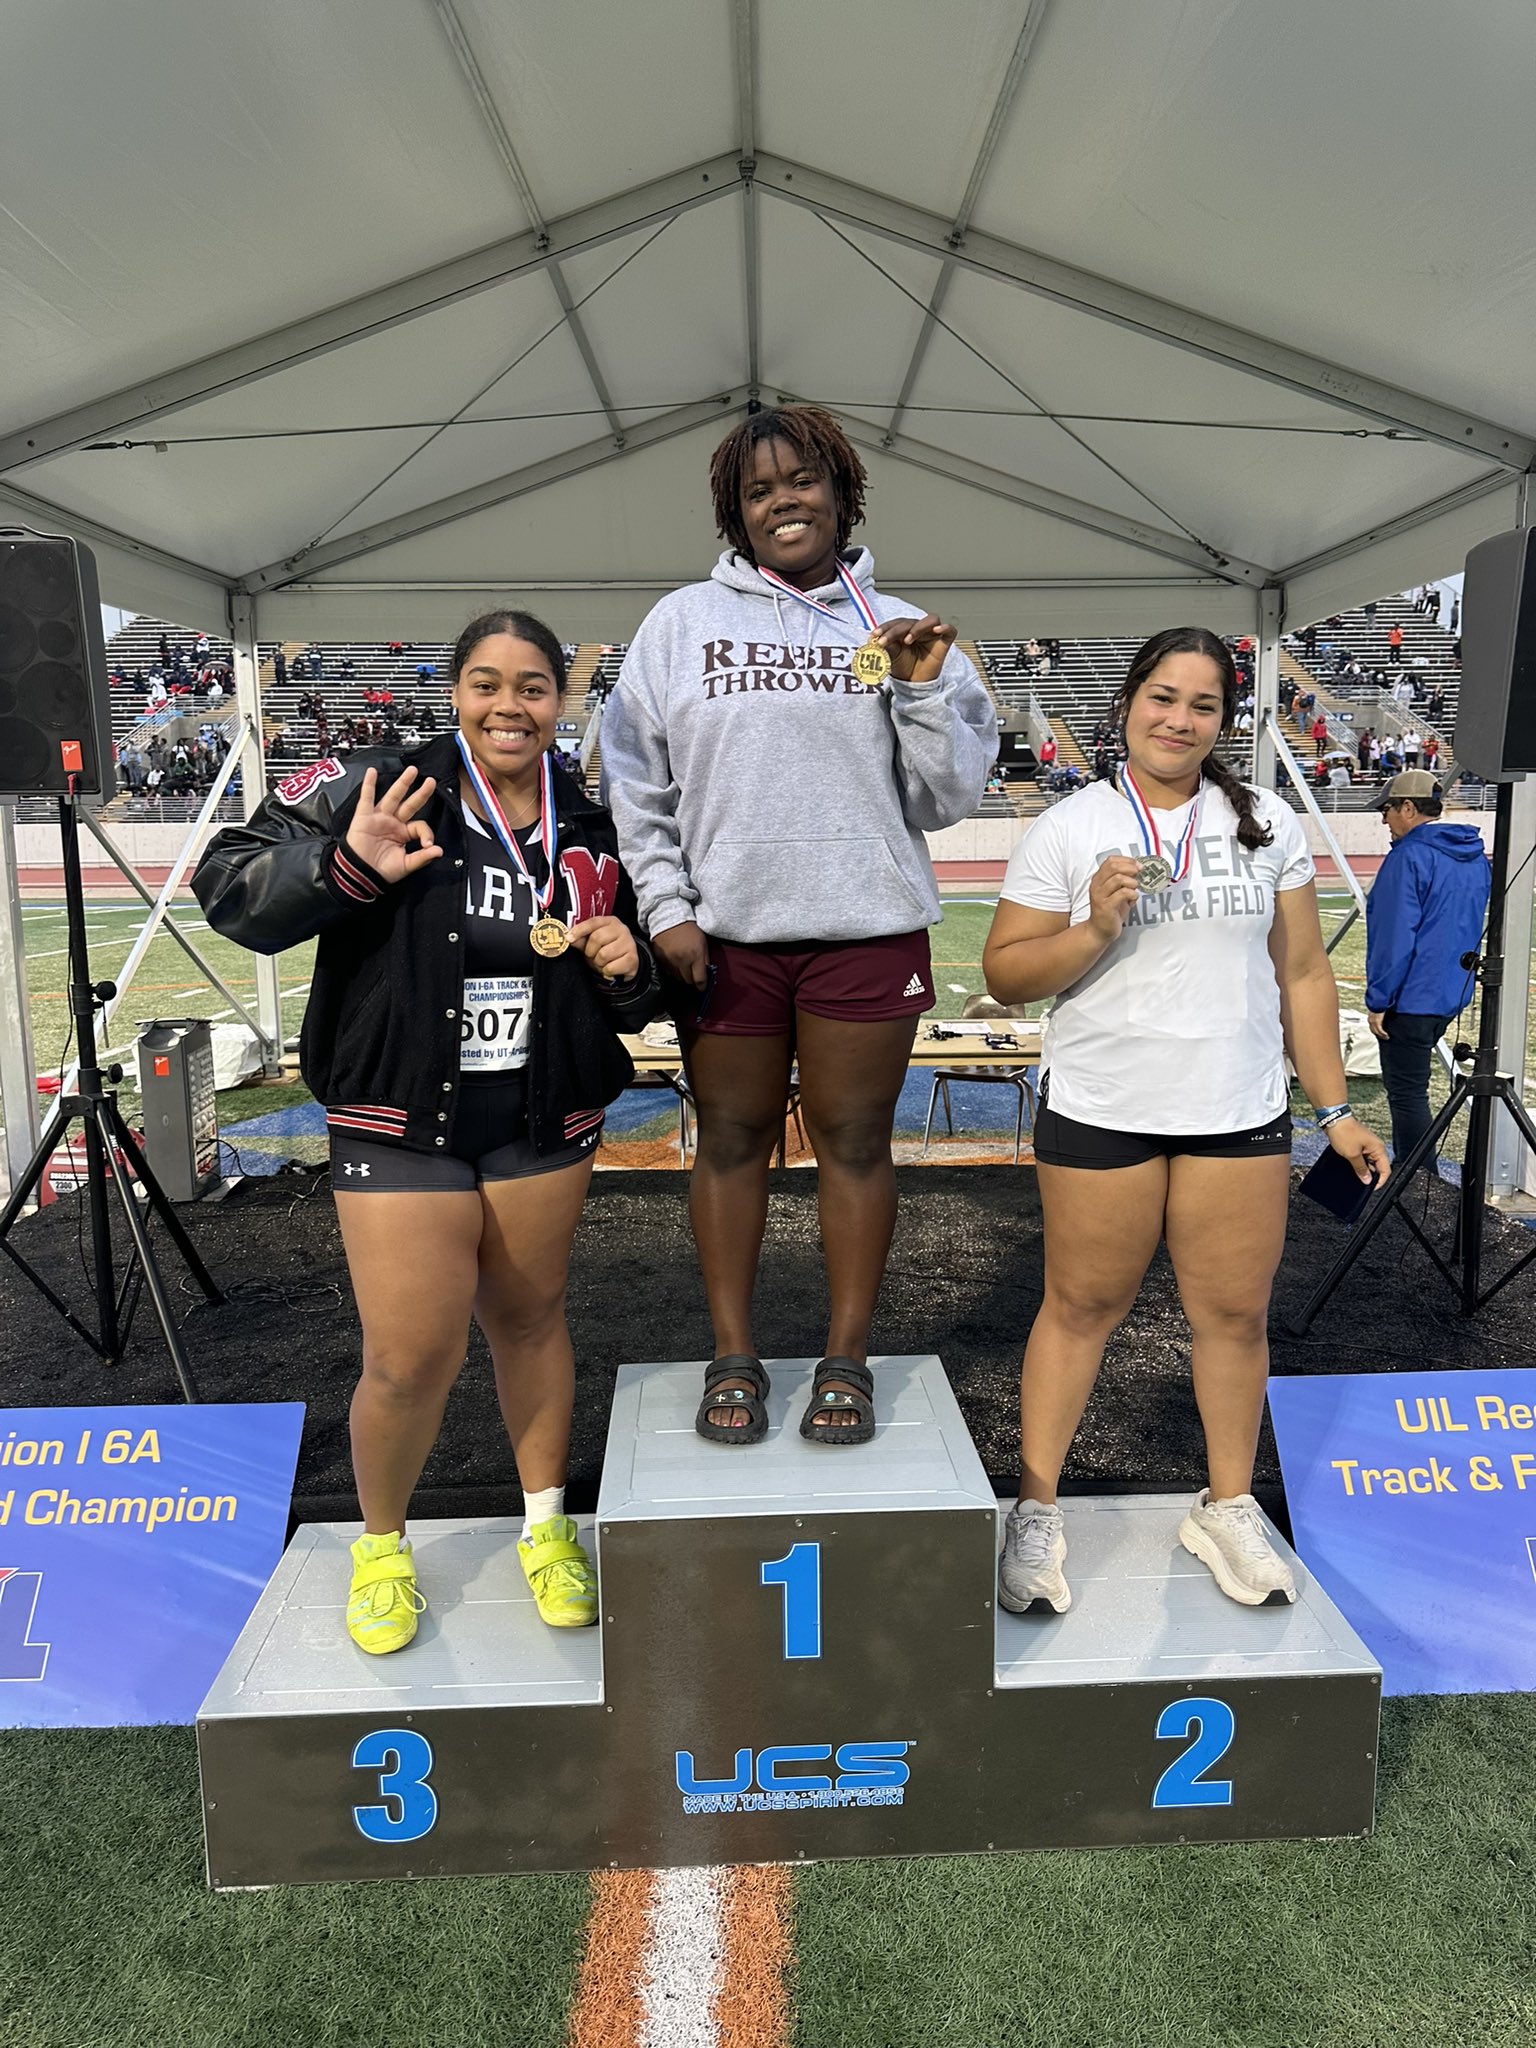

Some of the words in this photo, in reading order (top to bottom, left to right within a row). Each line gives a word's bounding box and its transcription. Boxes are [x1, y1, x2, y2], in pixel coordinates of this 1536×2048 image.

[702, 639, 857, 676] REBE
[1182, 889, 1200, 920] &
[1207, 885, 1266, 918] FIELD
[469, 990, 530, 1001] CHAMPIONSHIPS
[497, 980, 519, 990] TRACK
[521, 980, 528, 989] &
[903, 985, 926, 997] adidas
[460, 1008, 531, 1042] 607
[460, 1048, 482, 1058] sted
[484, 1048, 495, 1059] by
[1395, 1397, 1469, 1434] UIL
[1475, 1395, 1536, 1431] Re
[0, 1432, 64, 1466] ion
[101, 1429, 162, 1464] 6A
[1331, 1457, 1458, 1496] Track
[1469, 1455, 1504, 1492] &
[24, 1487, 238, 1533] Champion
[760, 1542, 821, 1659] 1
[1152, 1697, 1236, 1808] 2
[352, 1728, 438, 1843] 3
[683, 1795, 722, 1805] MADE
[723, 1795, 738, 1804] IN
[738, 1793, 765, 1803] THE
[683, 1795, 904, 1814] WWW.UCSSPIRIT.COM
